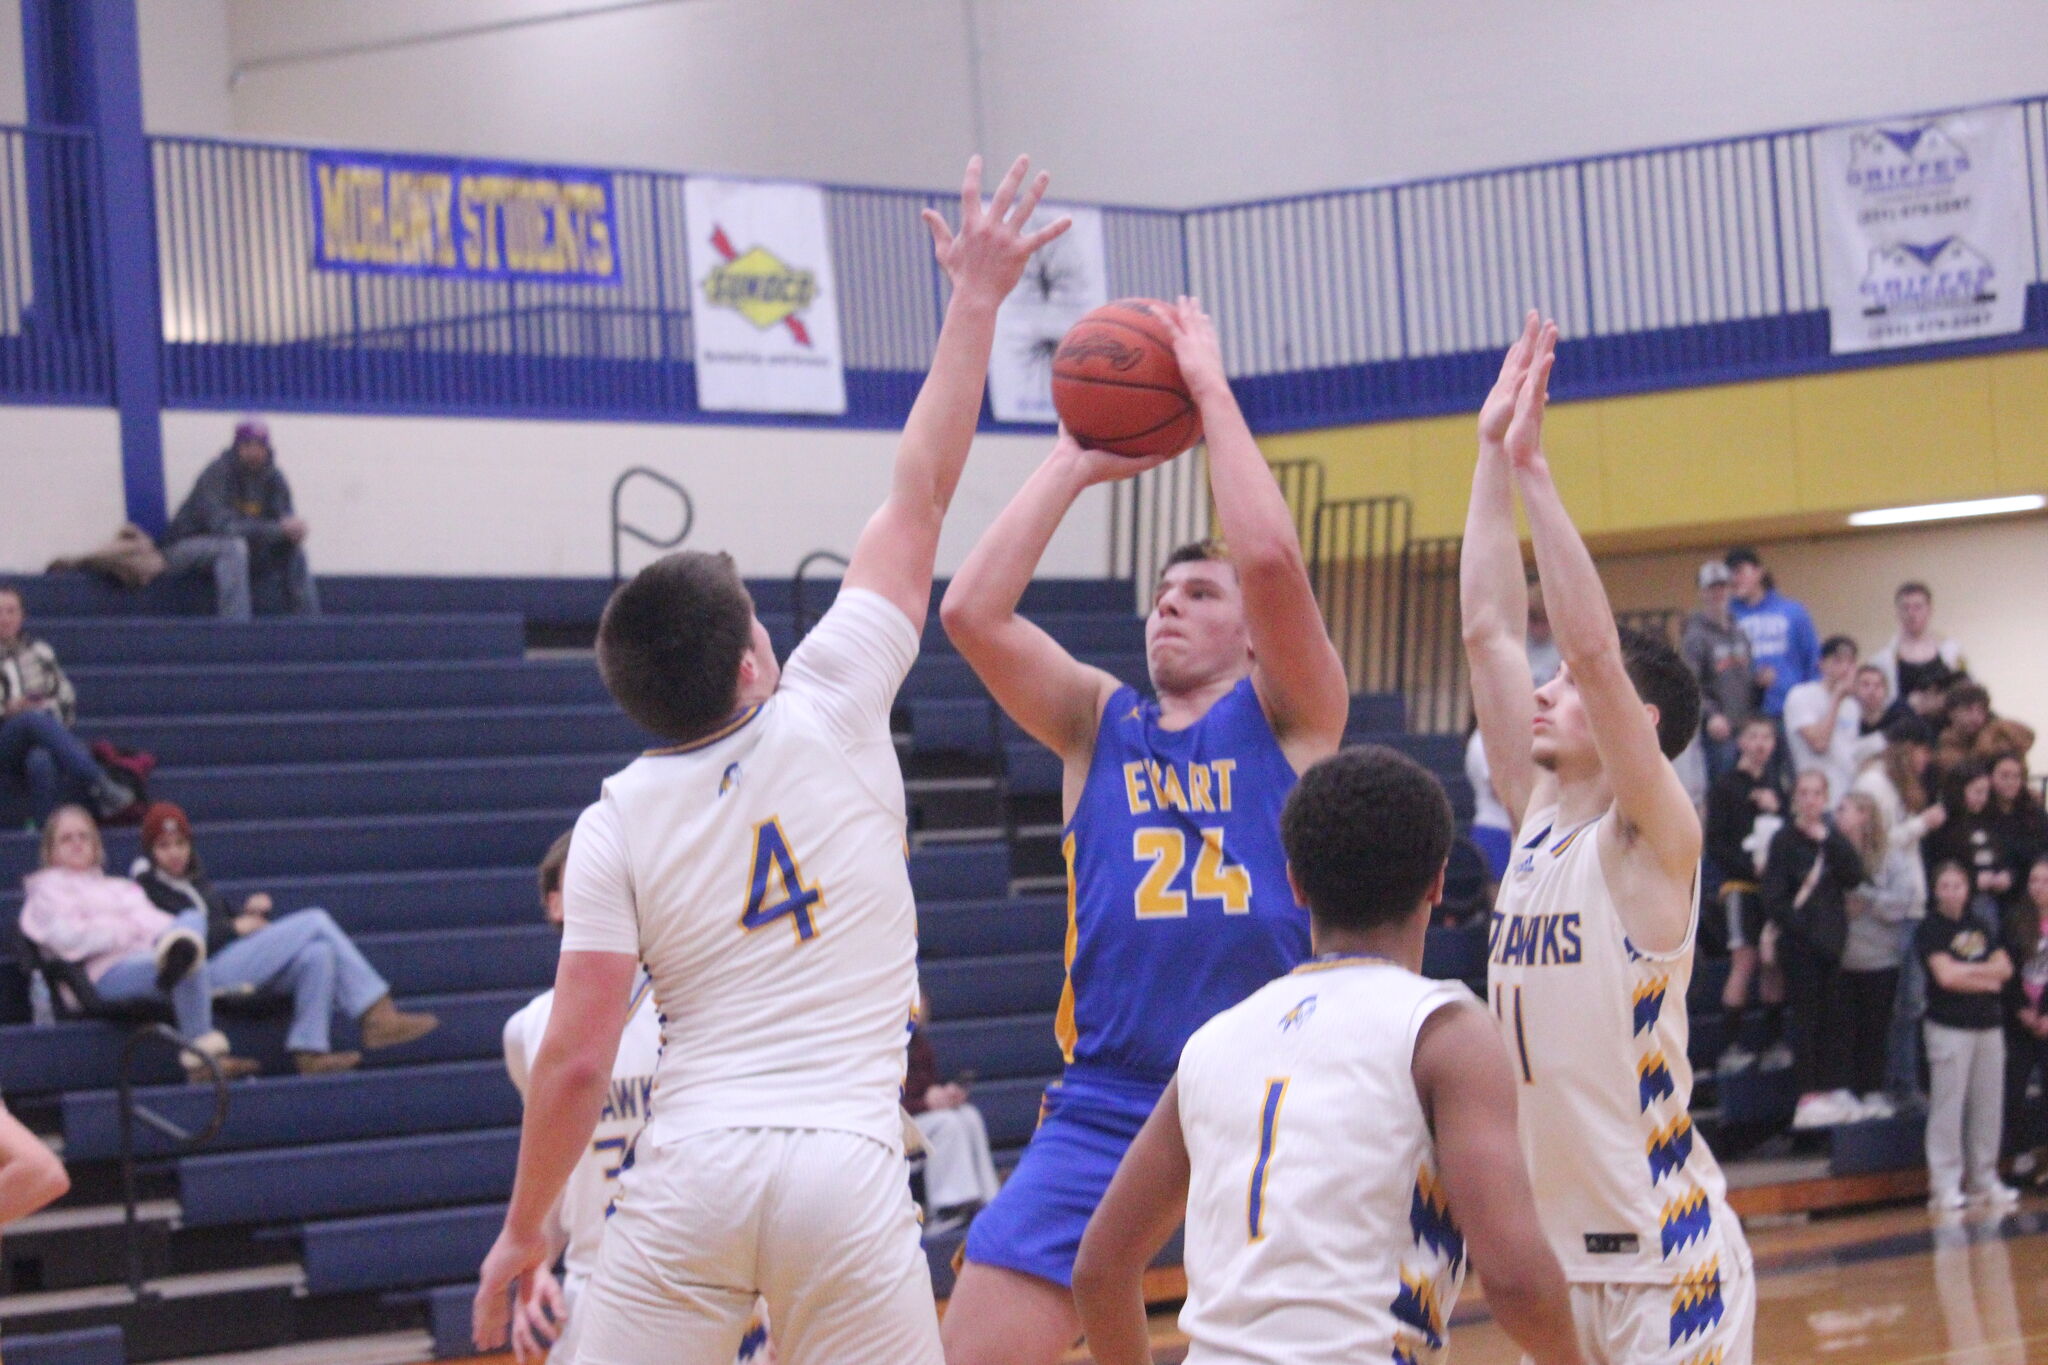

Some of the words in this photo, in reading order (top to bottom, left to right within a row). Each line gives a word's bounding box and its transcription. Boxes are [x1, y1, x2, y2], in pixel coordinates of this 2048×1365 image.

[458, 174, 614, 278] STUDENTS
[1122, 757, 1238, 816] EVART
[737, 812, 828, 948] 4
[1132, 826, 1253, 920] 24
[1247, 1075, 1292, 1245] 1
